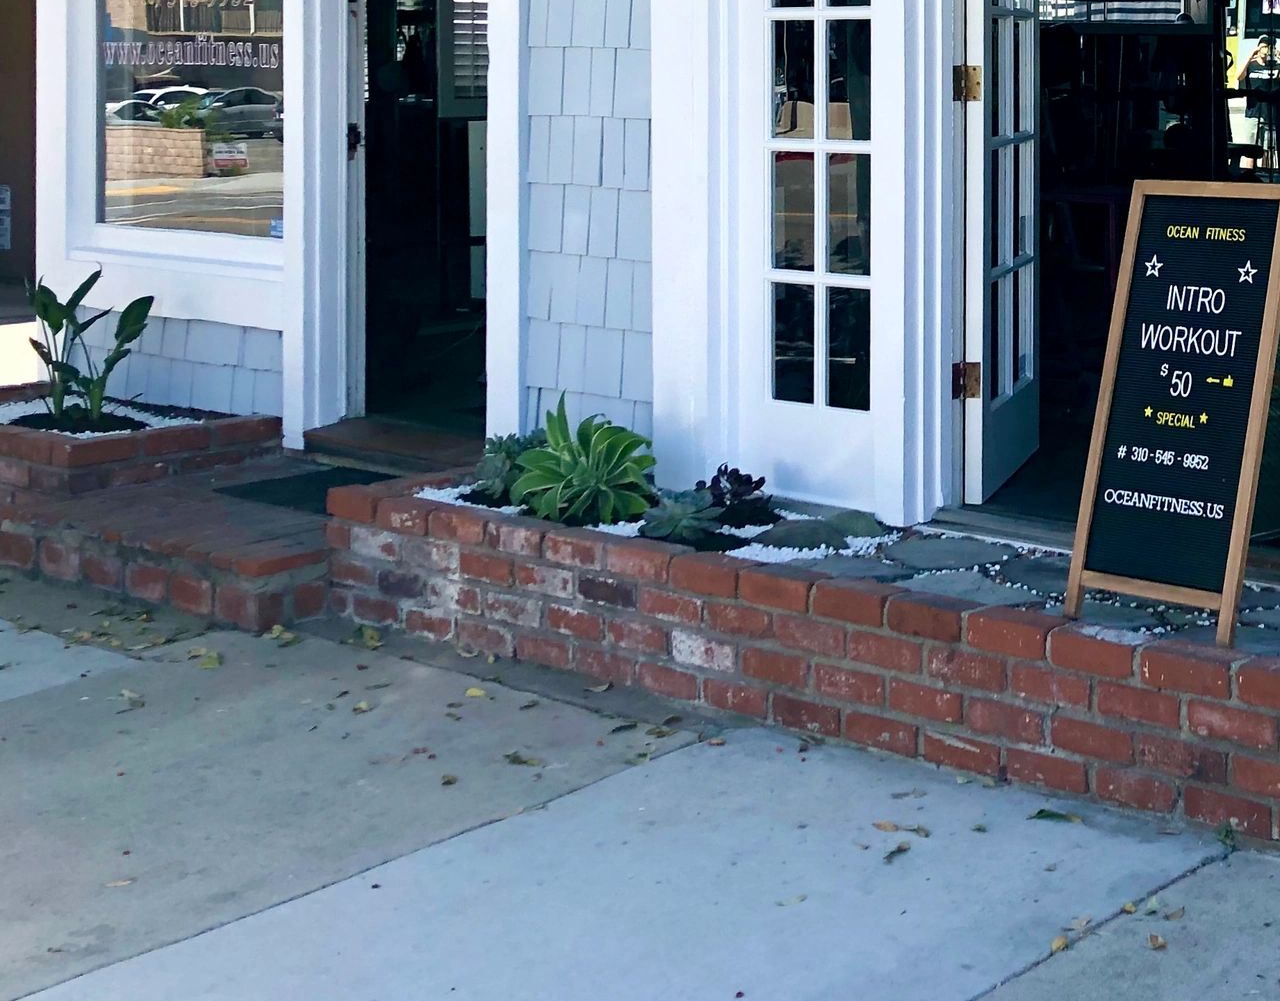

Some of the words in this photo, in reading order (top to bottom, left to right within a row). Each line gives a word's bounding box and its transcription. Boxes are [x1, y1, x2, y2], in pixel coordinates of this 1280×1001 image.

[102, 31, 280, 69] www.oceanfitness.us
[1166, 225, 1200, 240] OCEAN
[1205, 226, 1247, 242] FITNESS
[1166, 284, 1226, 314] INTRO
[1141, 322, 1243, 358] WORKOUT
[1155, 410, 1196, 429] SPECIAL
[1116, 444, 1128, 460] #
[1103, 488, 1225, 520] OCEANFITNESS.US
